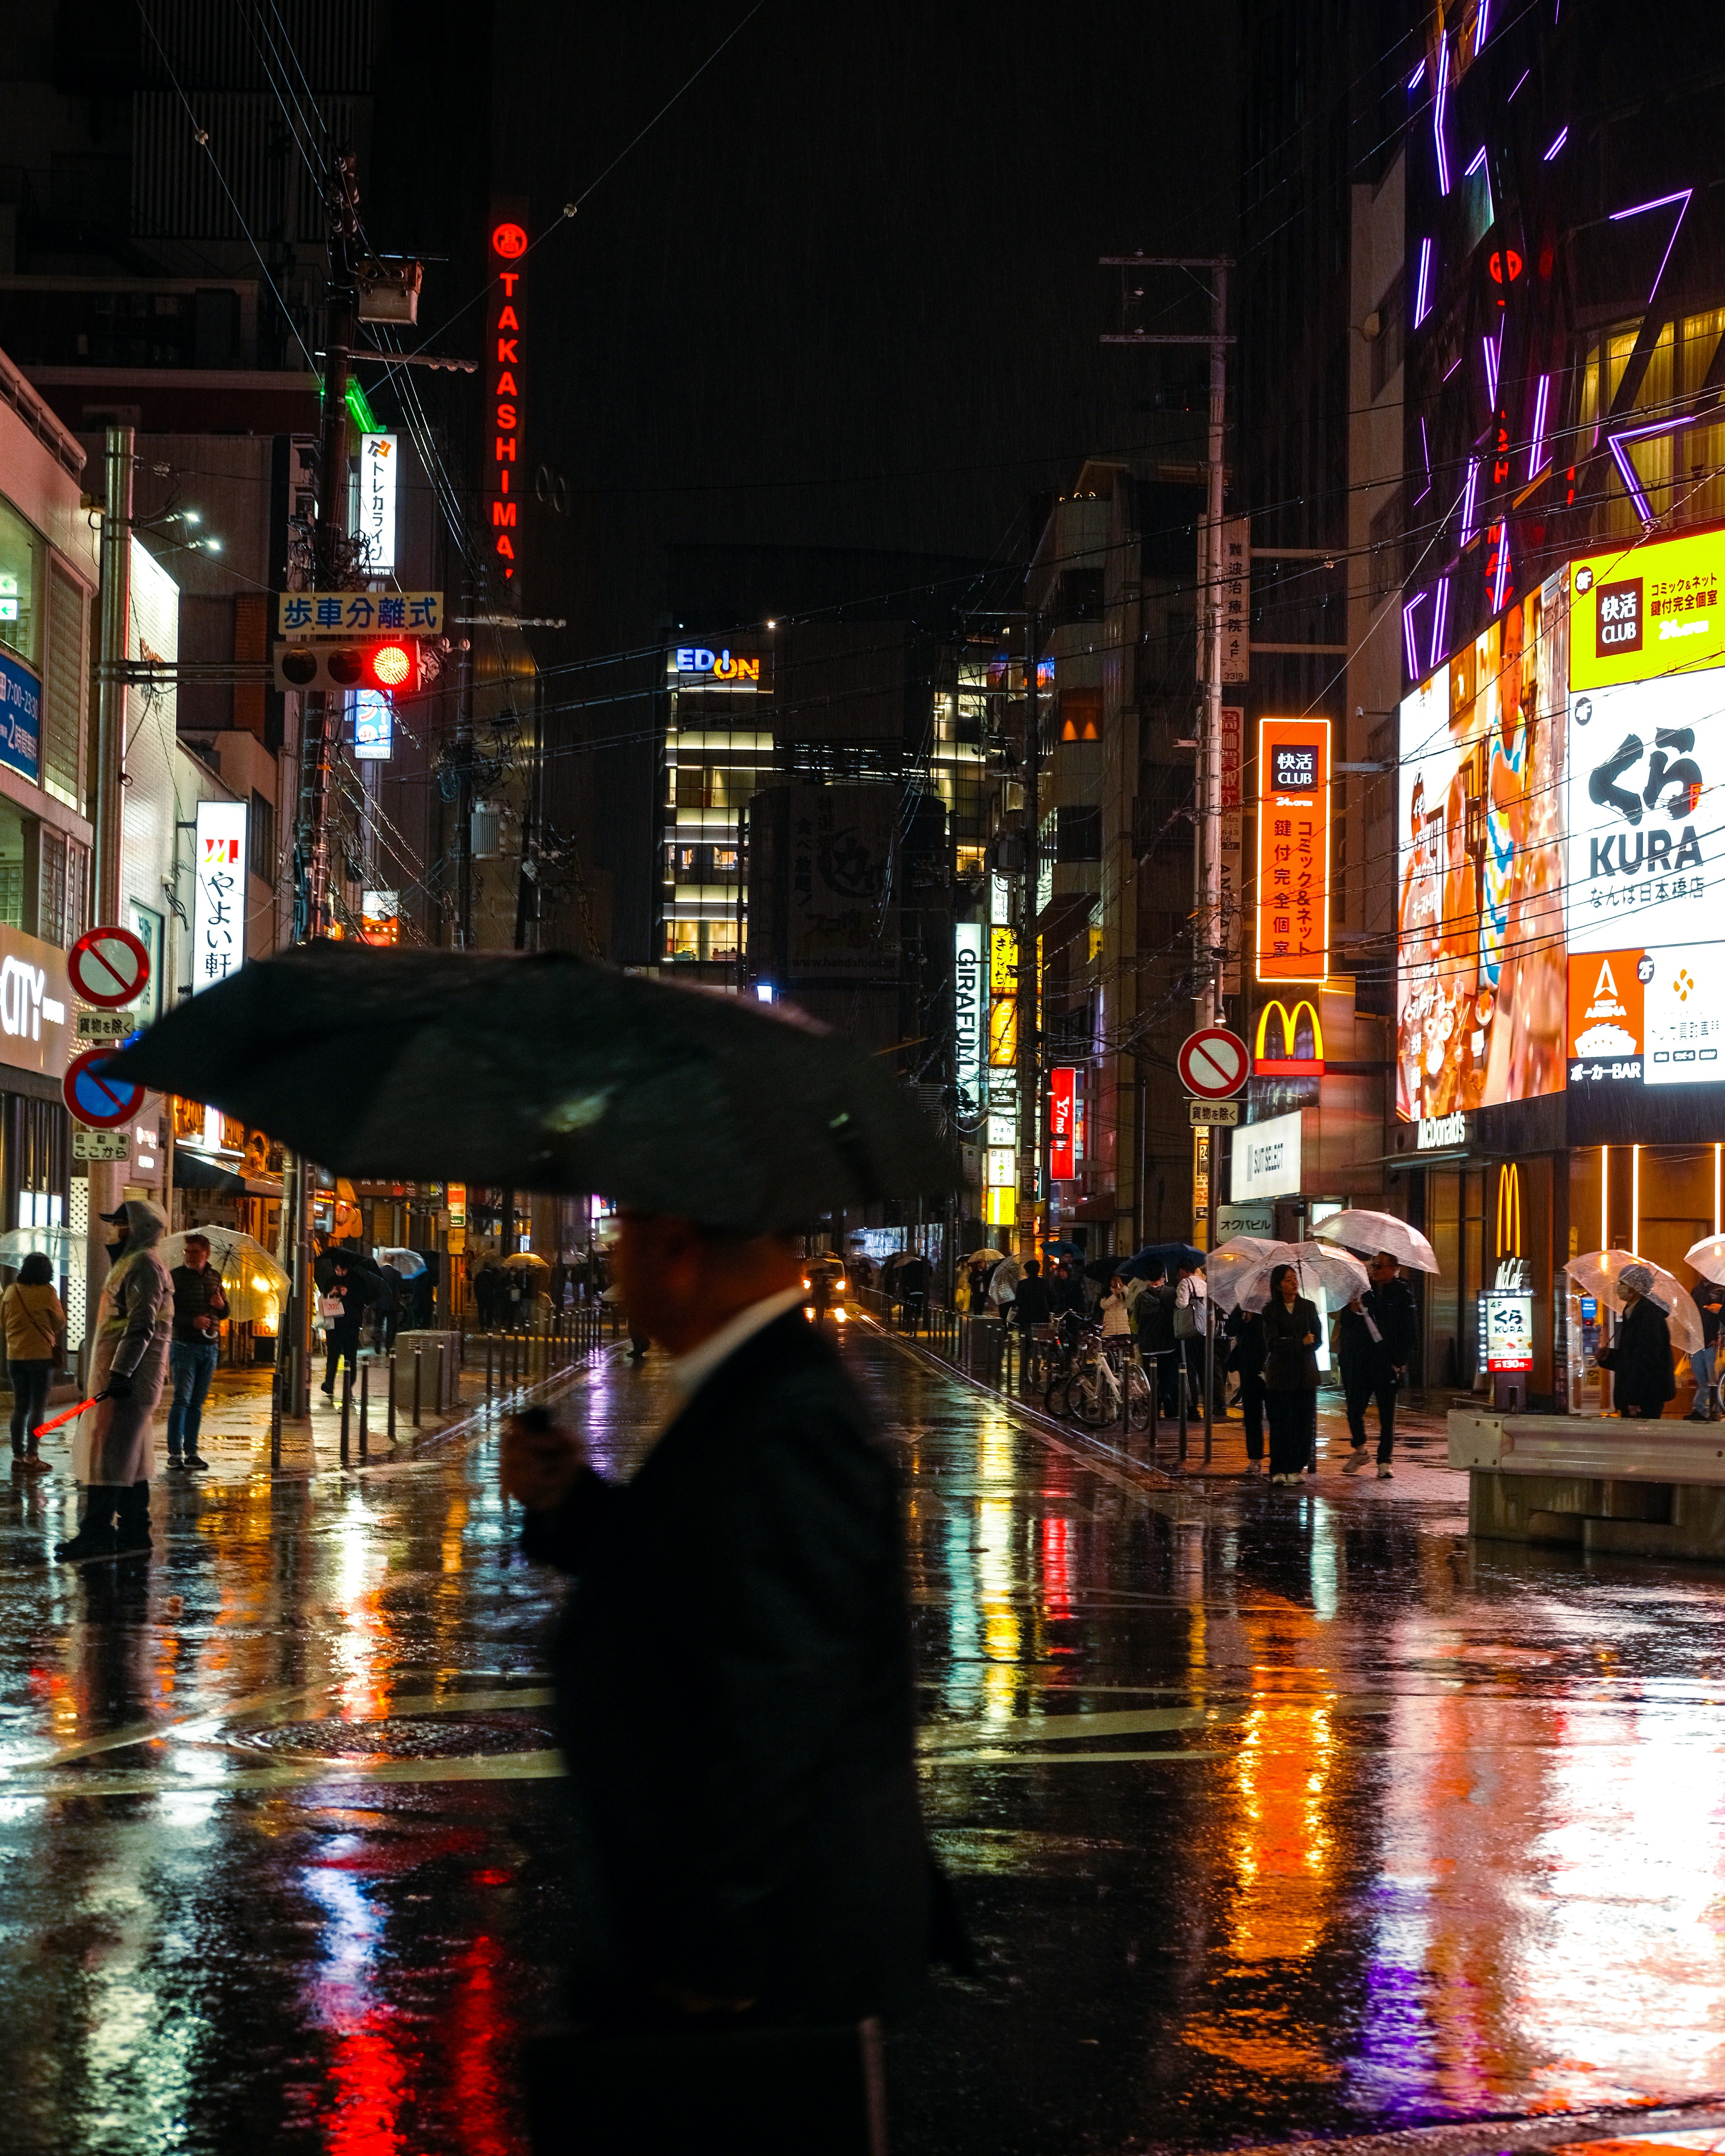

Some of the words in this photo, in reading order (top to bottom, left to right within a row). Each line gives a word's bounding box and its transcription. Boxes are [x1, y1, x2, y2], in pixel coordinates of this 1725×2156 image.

[493, 273, 519, 578] TAKASHIMA
[1576, 571, 1592, 590] 8F
[1651, 572, 1718, 596] コミック&ネット
[284, 596, 437, 630] 歩車分離式
[1601, 591, 1637, 622] 快活
[1650, 590, 1718, 617] 鍵付完全個室
[1601, 622, 1637, 644] CLUB
[676, 649, 759, 680] EDION
[1577, 704, 1591, 722] 4F
[1277, 753, 1313, 770] 快活
[1278, 772, 1312, 784] CLUB
[1588, 726, 1703, 826] くら
[1591, 826, 1704, 877] KURA
[1273, 820, 1291, 957] 鍵付完全個室
[1296, 821, 1314, 957] コミック&ネット
[1591, 876, 1705, 908] なんば日本橋店
[205, 871, 234, 978] やよい軒
[1638, 961, 1654, 980] 2F
[956, 949, 976, 1074] GIRAFULL
[1584, 1005, 1627, 1018] ARENA
[79, 1018, 131, 1034] 貨物を除く
[1570, 1062, 1641, 1081] ポーカーBAR
[1056, 1096, 1069, 1151] Y!moile
[1192, 1107, 1235, 1120] 貨物を除く
[76, 1134, 126, 1144] 自動車
[1417, 1110, 1465, 1149] McDonald's
[75, 1145, 127, 1159] ここから
[1254, 1148, 1264, 1174] SUIT
[1265, 1143, 1284, 1172] SELECT
[1221, 1219, 1271, 1231] オクバビル
[1494, 1309, 1522, 1325] くら
